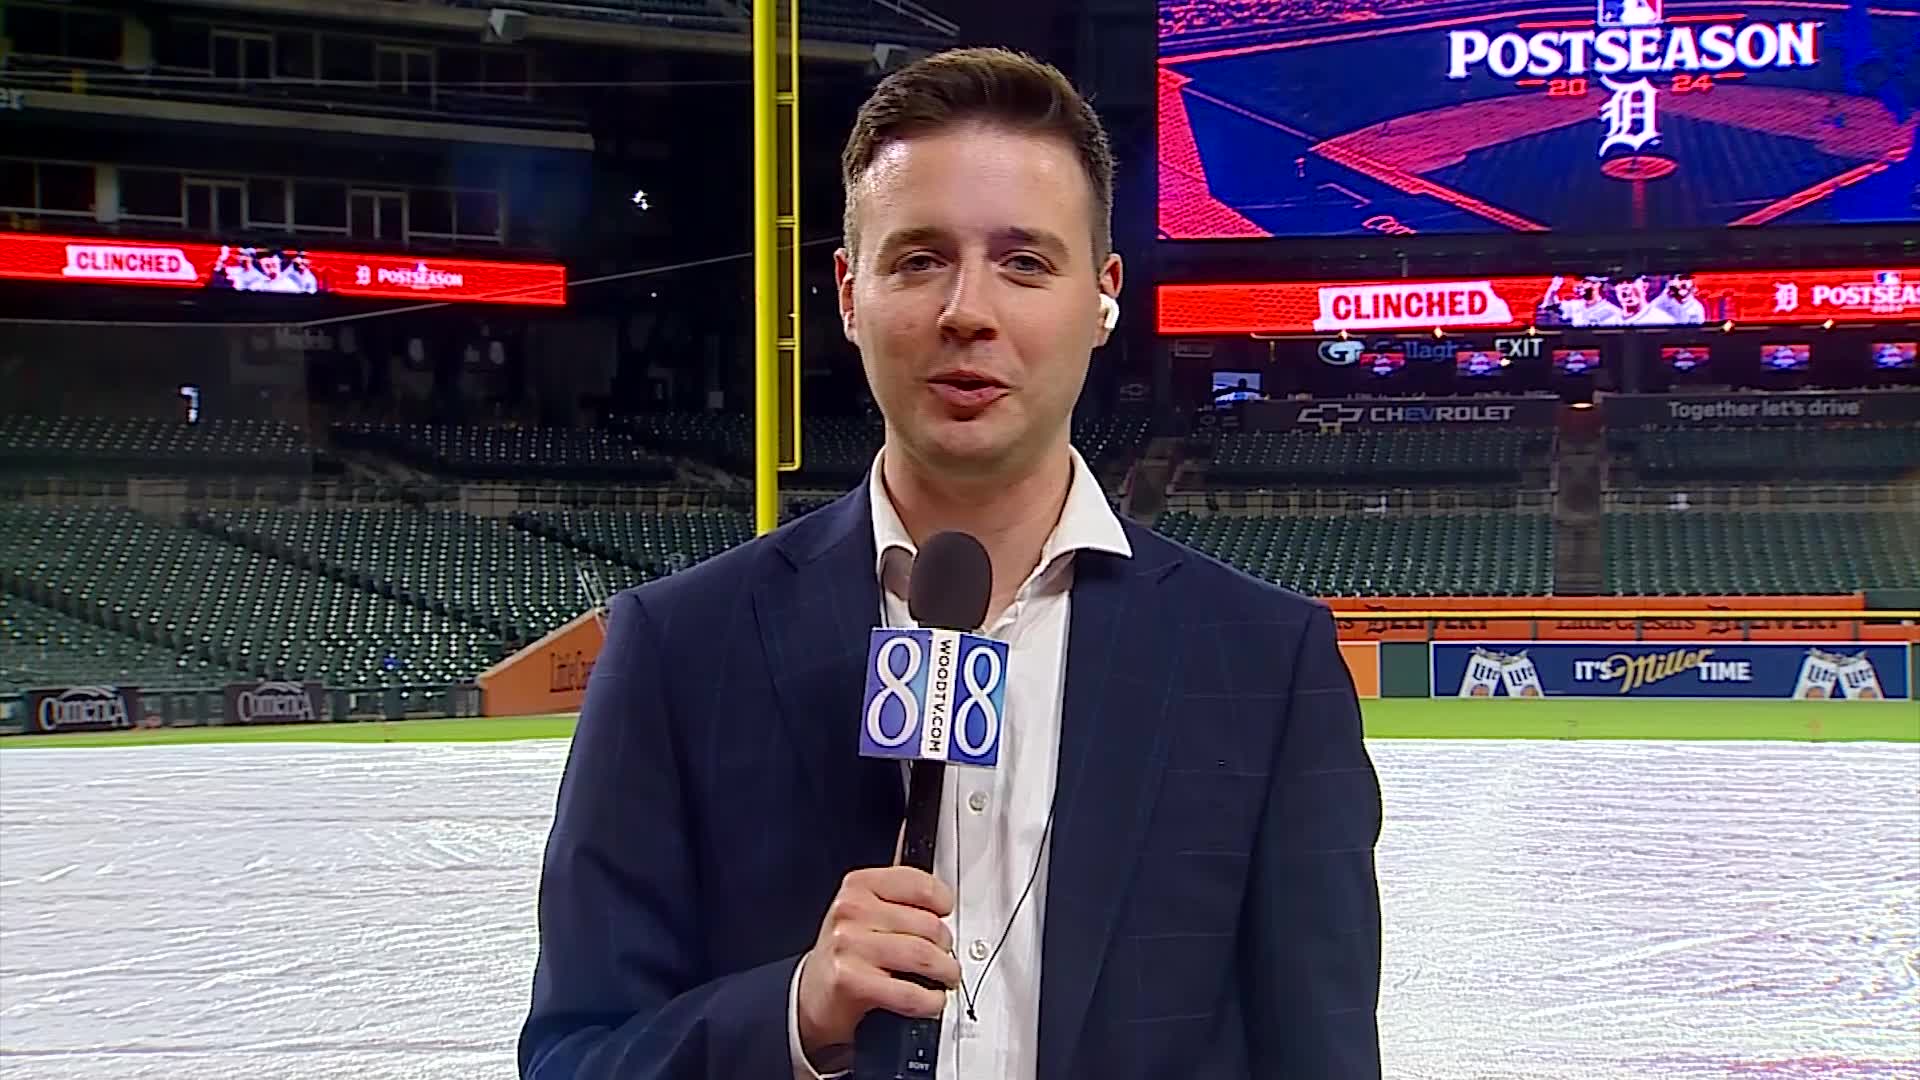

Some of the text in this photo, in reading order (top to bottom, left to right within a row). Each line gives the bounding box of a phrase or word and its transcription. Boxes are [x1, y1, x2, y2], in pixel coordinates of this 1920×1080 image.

[1449, 22, 1821, 79] POSTSEASON
[1548, 75, 1713, 97] 20 24
[76, 252, 181, 273] CLINCHED
[378, 267, 463, 288] POSTSEASON
[1332, 290, 1488, 320] CLINCHED
[1494, 337, 1544, 358] EXIT
[1370, 405, 1516, 423] CHEVROLET
[1667, 399, 1860, 421] Together let's drive
[1574, 649, 1753, 694] IT'S Miller TIME
[867, 637, 922, 748] 8
[929, 639, 952, 753] WOODTV.COM
[954, 646, 1002, 757] 8
